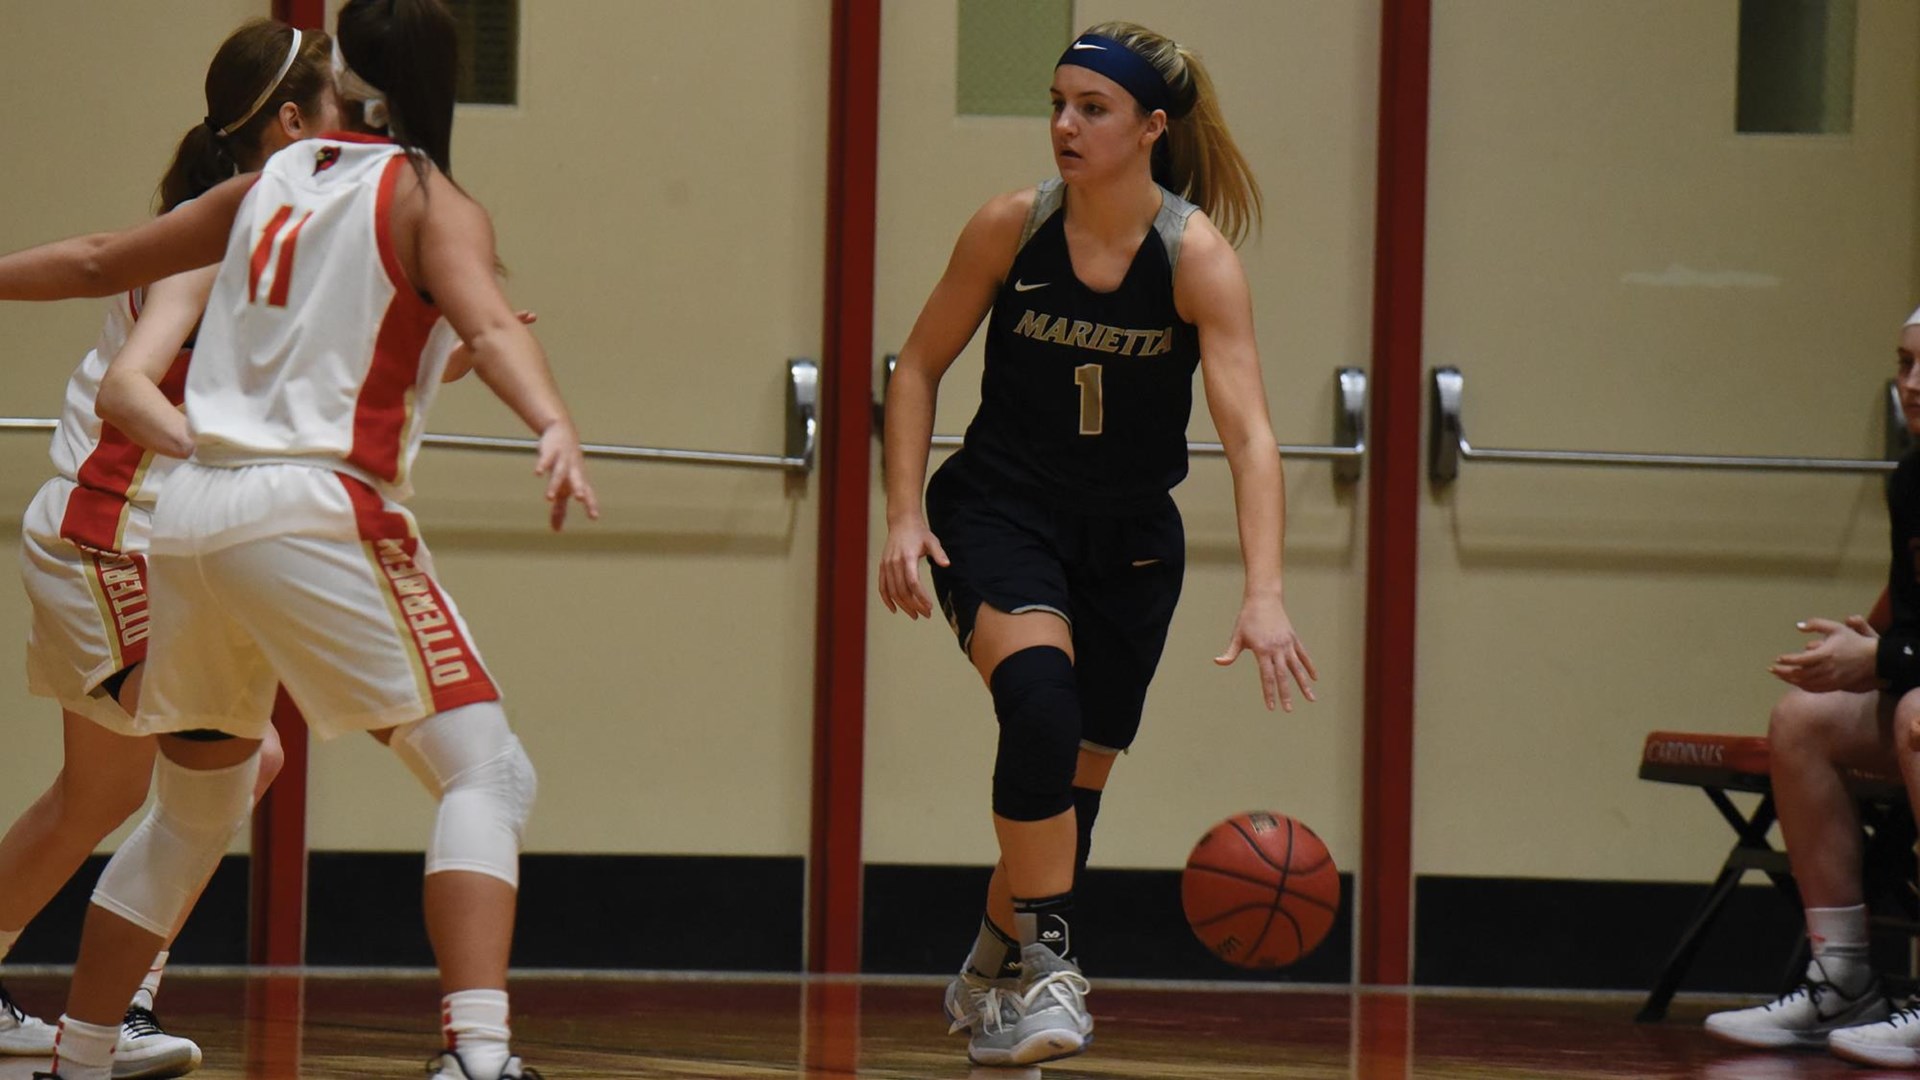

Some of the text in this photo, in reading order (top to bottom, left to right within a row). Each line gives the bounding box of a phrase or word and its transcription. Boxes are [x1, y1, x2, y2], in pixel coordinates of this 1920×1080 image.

[248, 203, 314, 308] 11
[1013, 309, 1172, 356] MARIETTA
[1074, 363, 1103, 435] 1
[377, 538, 470, 687] OTTERBEIN
